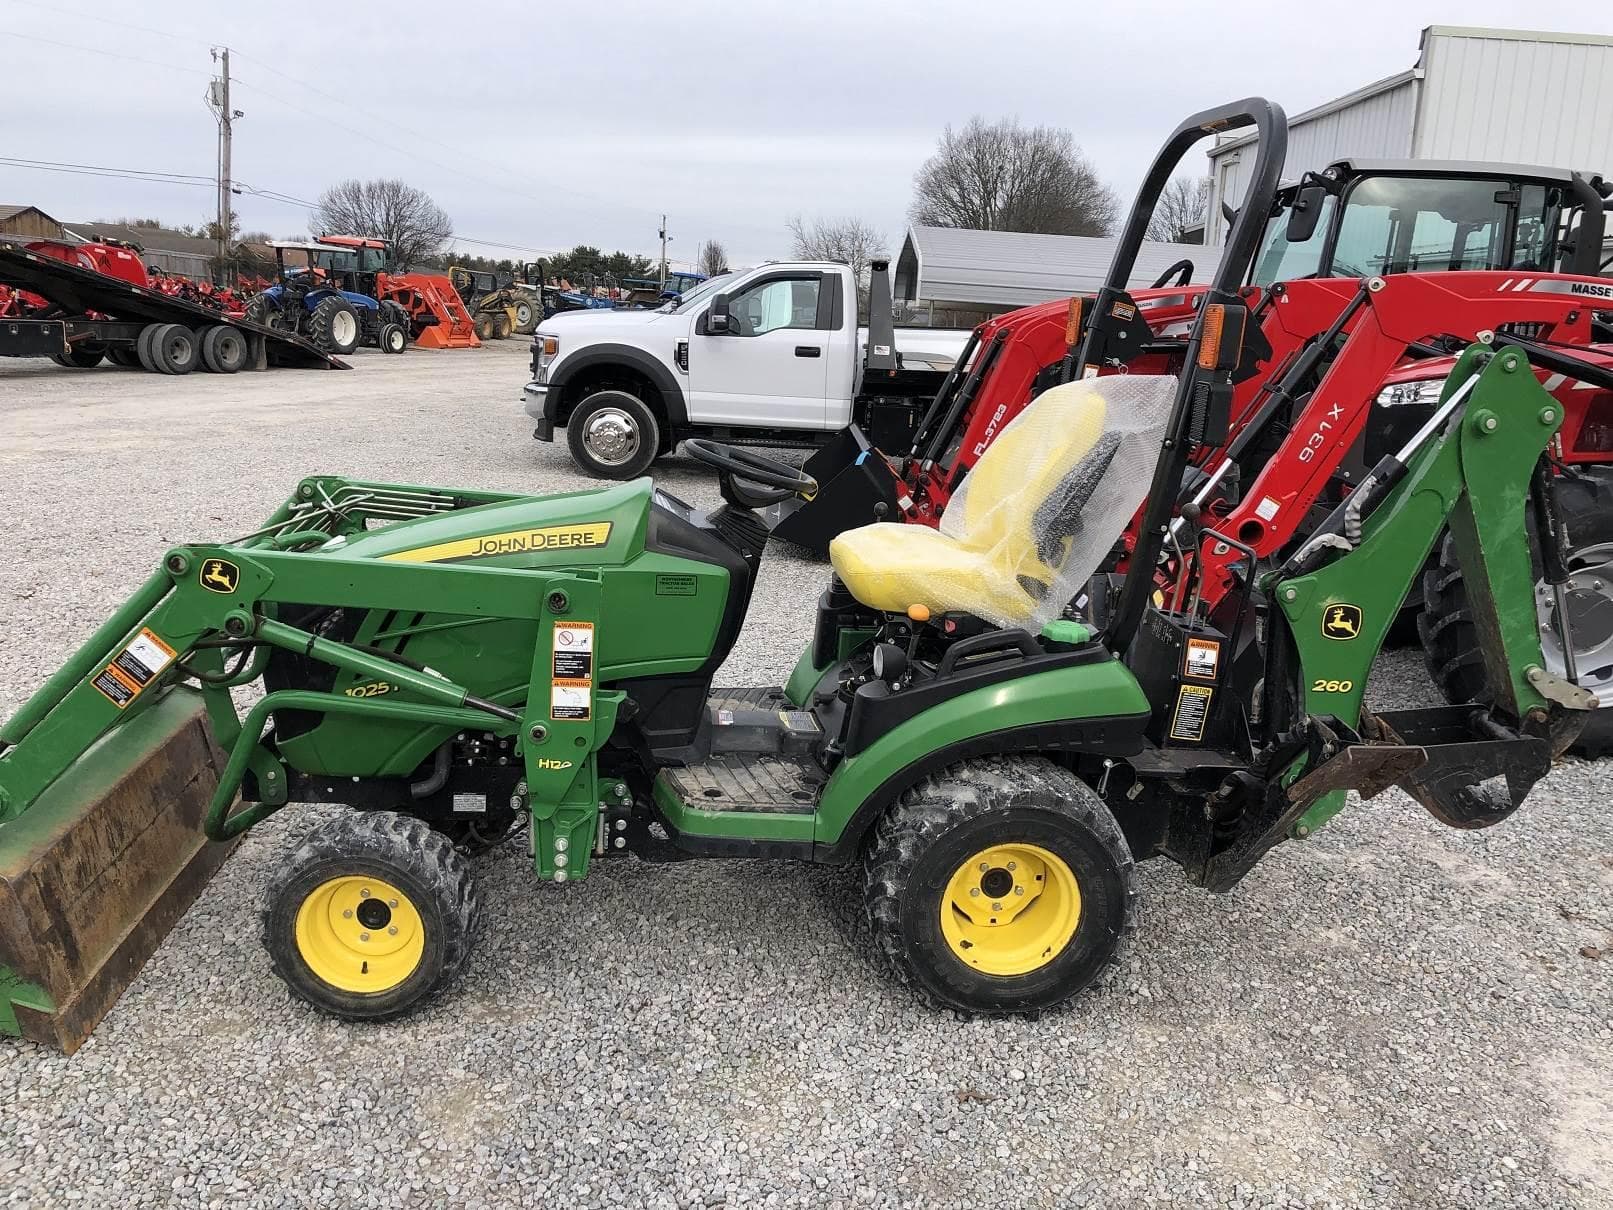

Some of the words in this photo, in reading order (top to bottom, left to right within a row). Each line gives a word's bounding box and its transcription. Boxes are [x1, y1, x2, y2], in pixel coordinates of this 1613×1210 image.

[1571, 283, 1613, 297] MASSE
[472, 539, 525, 554] JOHN
[531, 533, 594, 547] DEERE
[345, 682, 399, 698] 1025
[1312, 680, 1352, 692] 260
